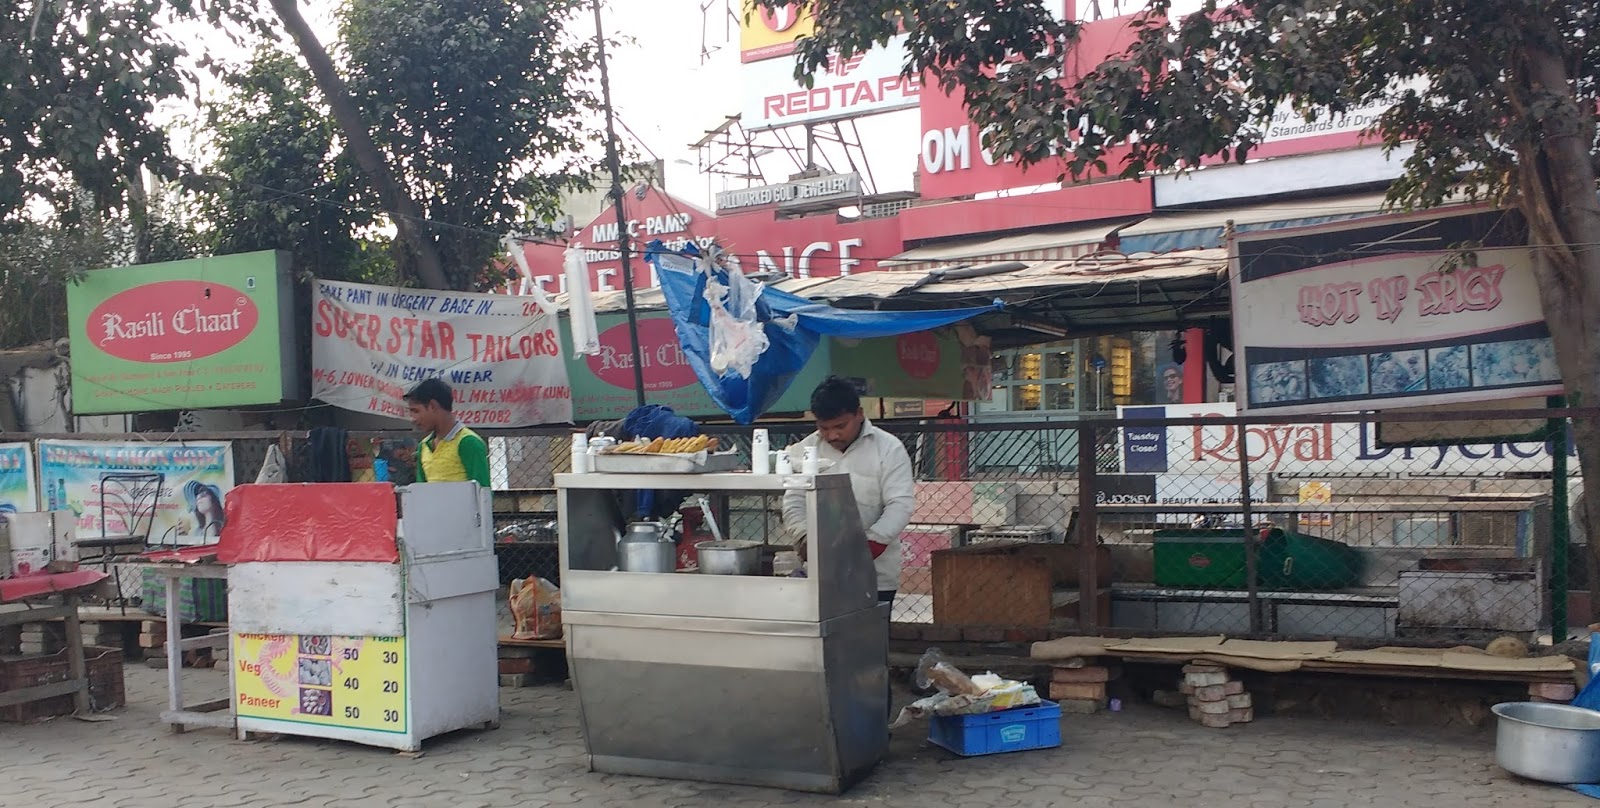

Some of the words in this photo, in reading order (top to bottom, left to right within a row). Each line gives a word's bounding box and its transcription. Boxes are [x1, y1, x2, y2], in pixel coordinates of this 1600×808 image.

[764, 72, 921, 119] REDTAPE
[1271, 120, 1333, 138] Standards
[1337, 115, 1352, 128] of
[921, 124, 971, 174] OM
[717, 189, 771, 209] HALLMARKED
[799, 177, 851, 199] JEWELLERY
[592, 213, 692, 243] MMC-PAMP
[346, 288, 372, 305] PANT
[376, 292, 389, 306] IN
[392, 293, 437, 311] URGENT
[439, 297, 474, 314] BASE
[1298, 281, 1363, 327] HOT
[1414, 263, 1506, 316] SPICY
[100, 311, 165, 347] Rasili
[172, 304, 242, 335] Chaat
[386, 316, 457, 361] STAR
[466, 328, 559, 363] TAILORS
[150, 352, 172, 361] Since
[173, 350, 192, 360] 1995
[597, 344, 652, 375] Rasli
[450, 370, 492, 384] WEAR
[1127, 432, 1160, 442] Tuesday
[1130, 444, 1158, 453] Closed
[1189, 412, 1333, 472] Royal
[1107, 494, 1152, 504] JOCKEY
[344, 648, 359, 661] 50
[383, 651, 399, 664] 30
[238, 660, 262, 677] Veg
[344, 677, 359, 690] 40
[383, 681, 399, 694] 20
[239, 693, 281, 709] Paneer
[345, 706, 360, 719] 50
[383, 709, 399, 723] 30
